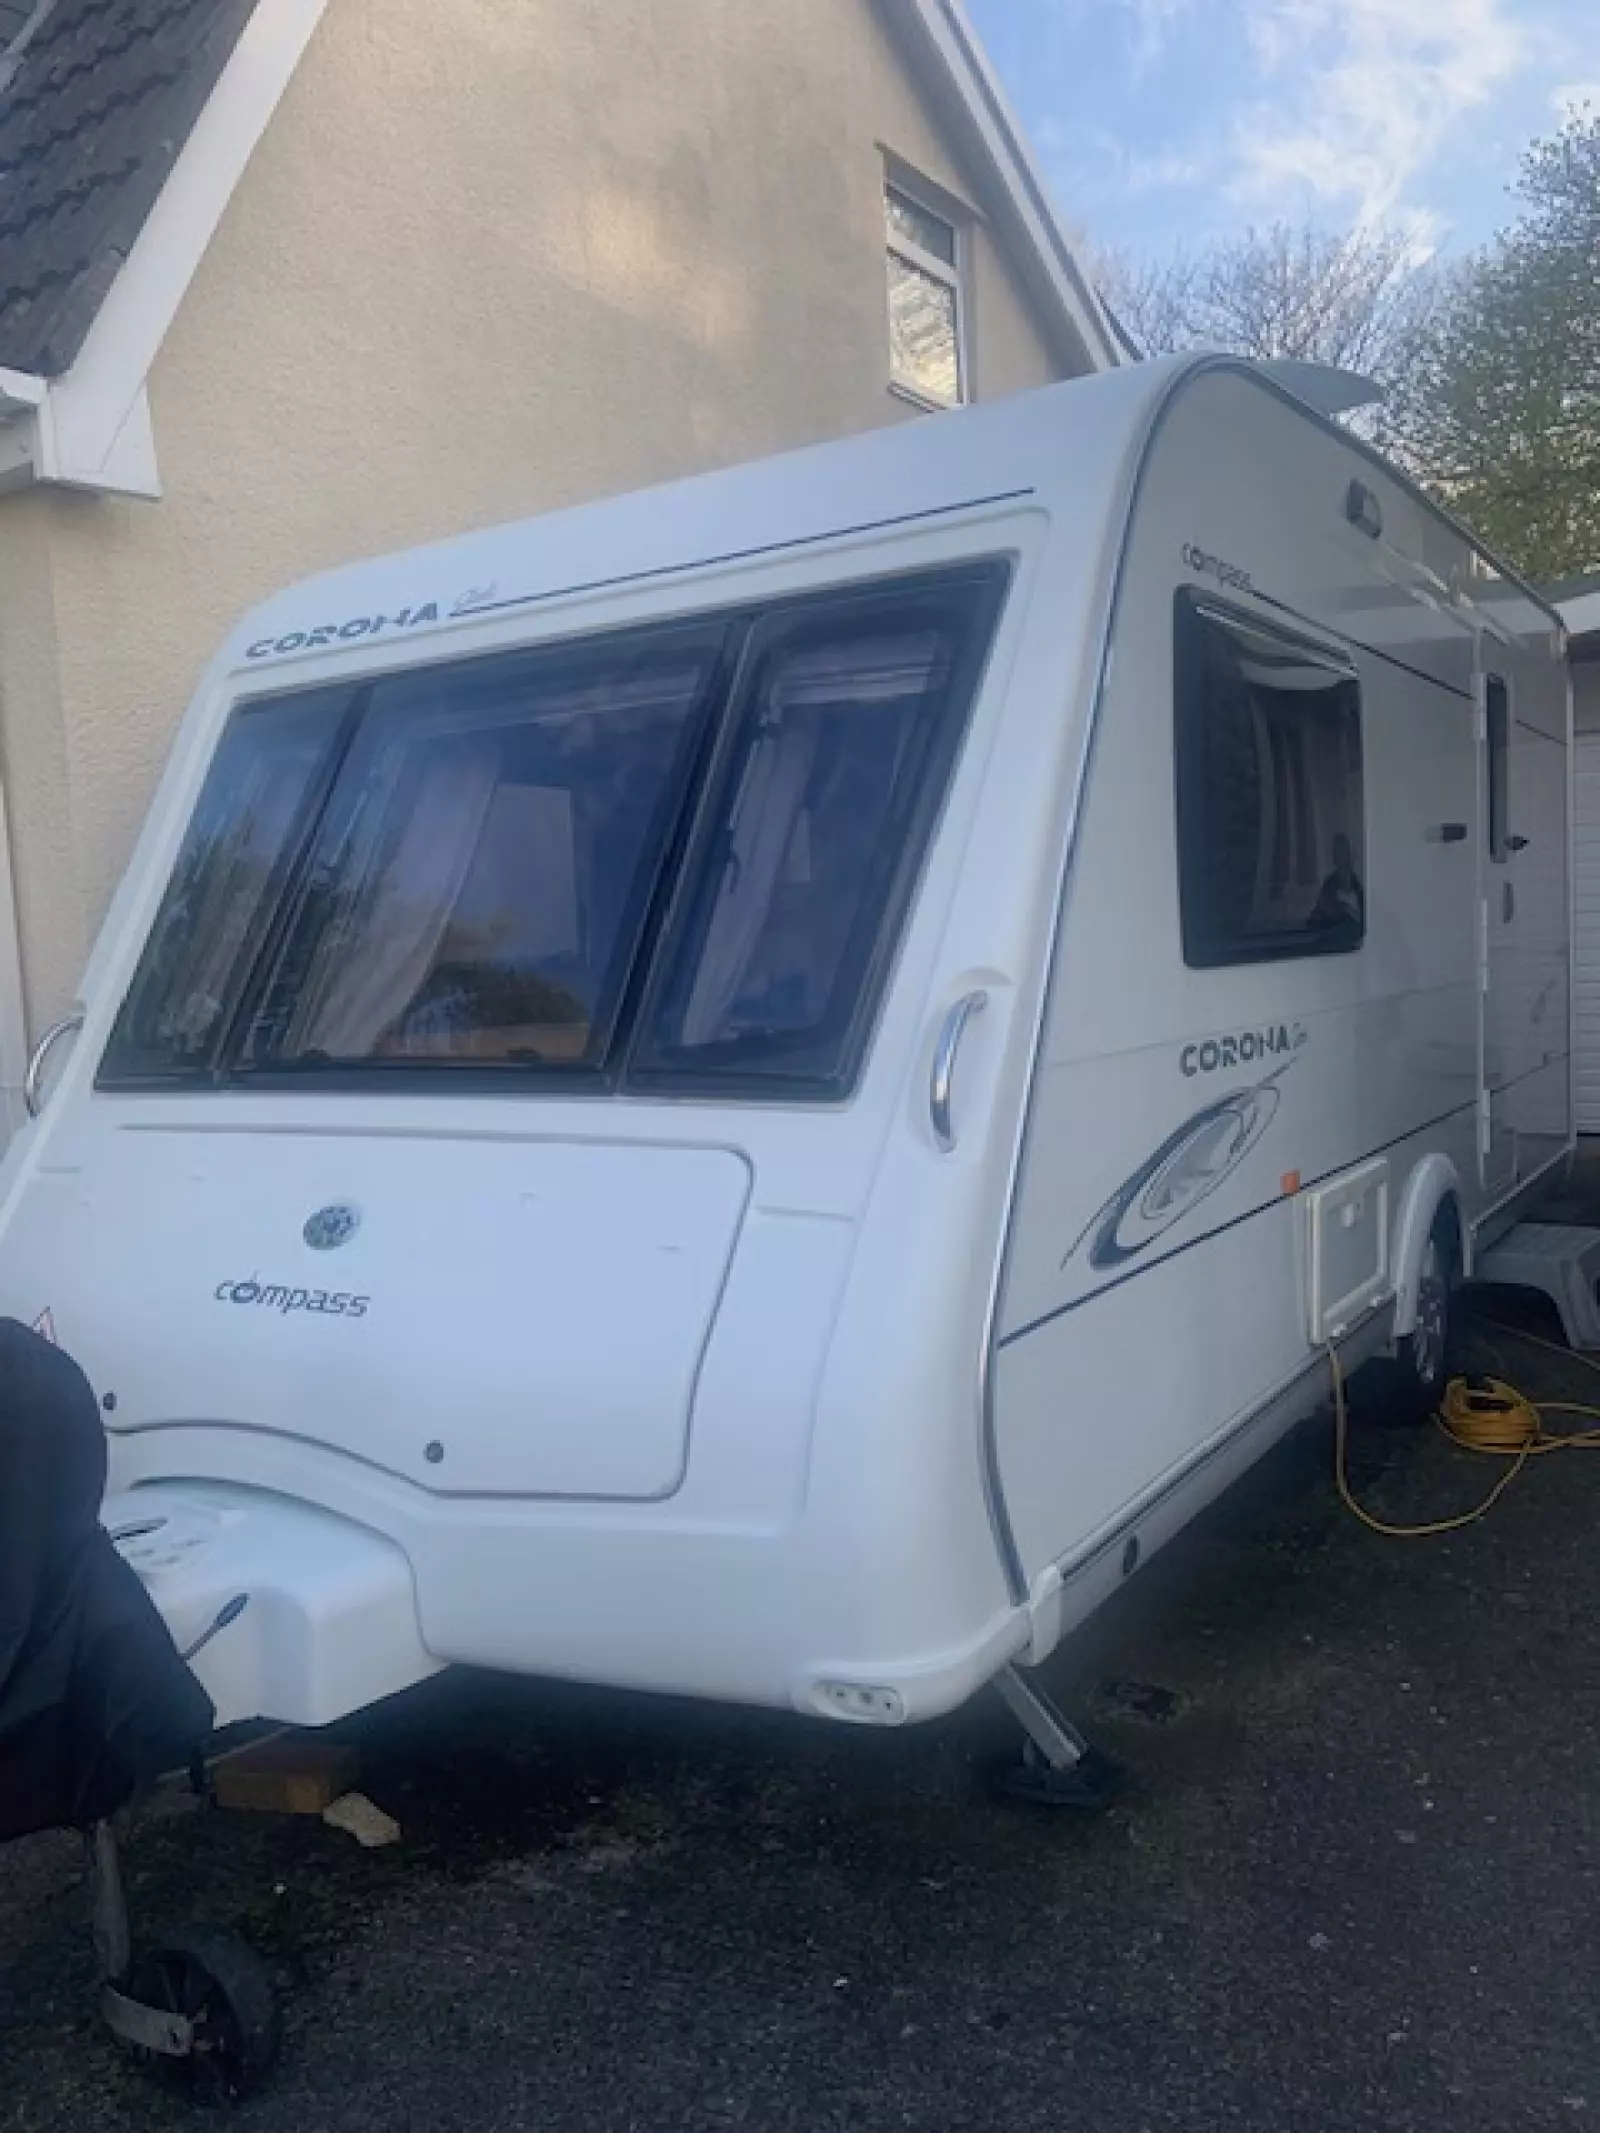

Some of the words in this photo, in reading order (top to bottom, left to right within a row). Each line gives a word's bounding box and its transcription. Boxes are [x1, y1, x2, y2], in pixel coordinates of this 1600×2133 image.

[246, 602, 437, 657] CORONA
[1180, 1025, 1291, 1077] CORONA
[214, 1273, 370, 1317] compass
